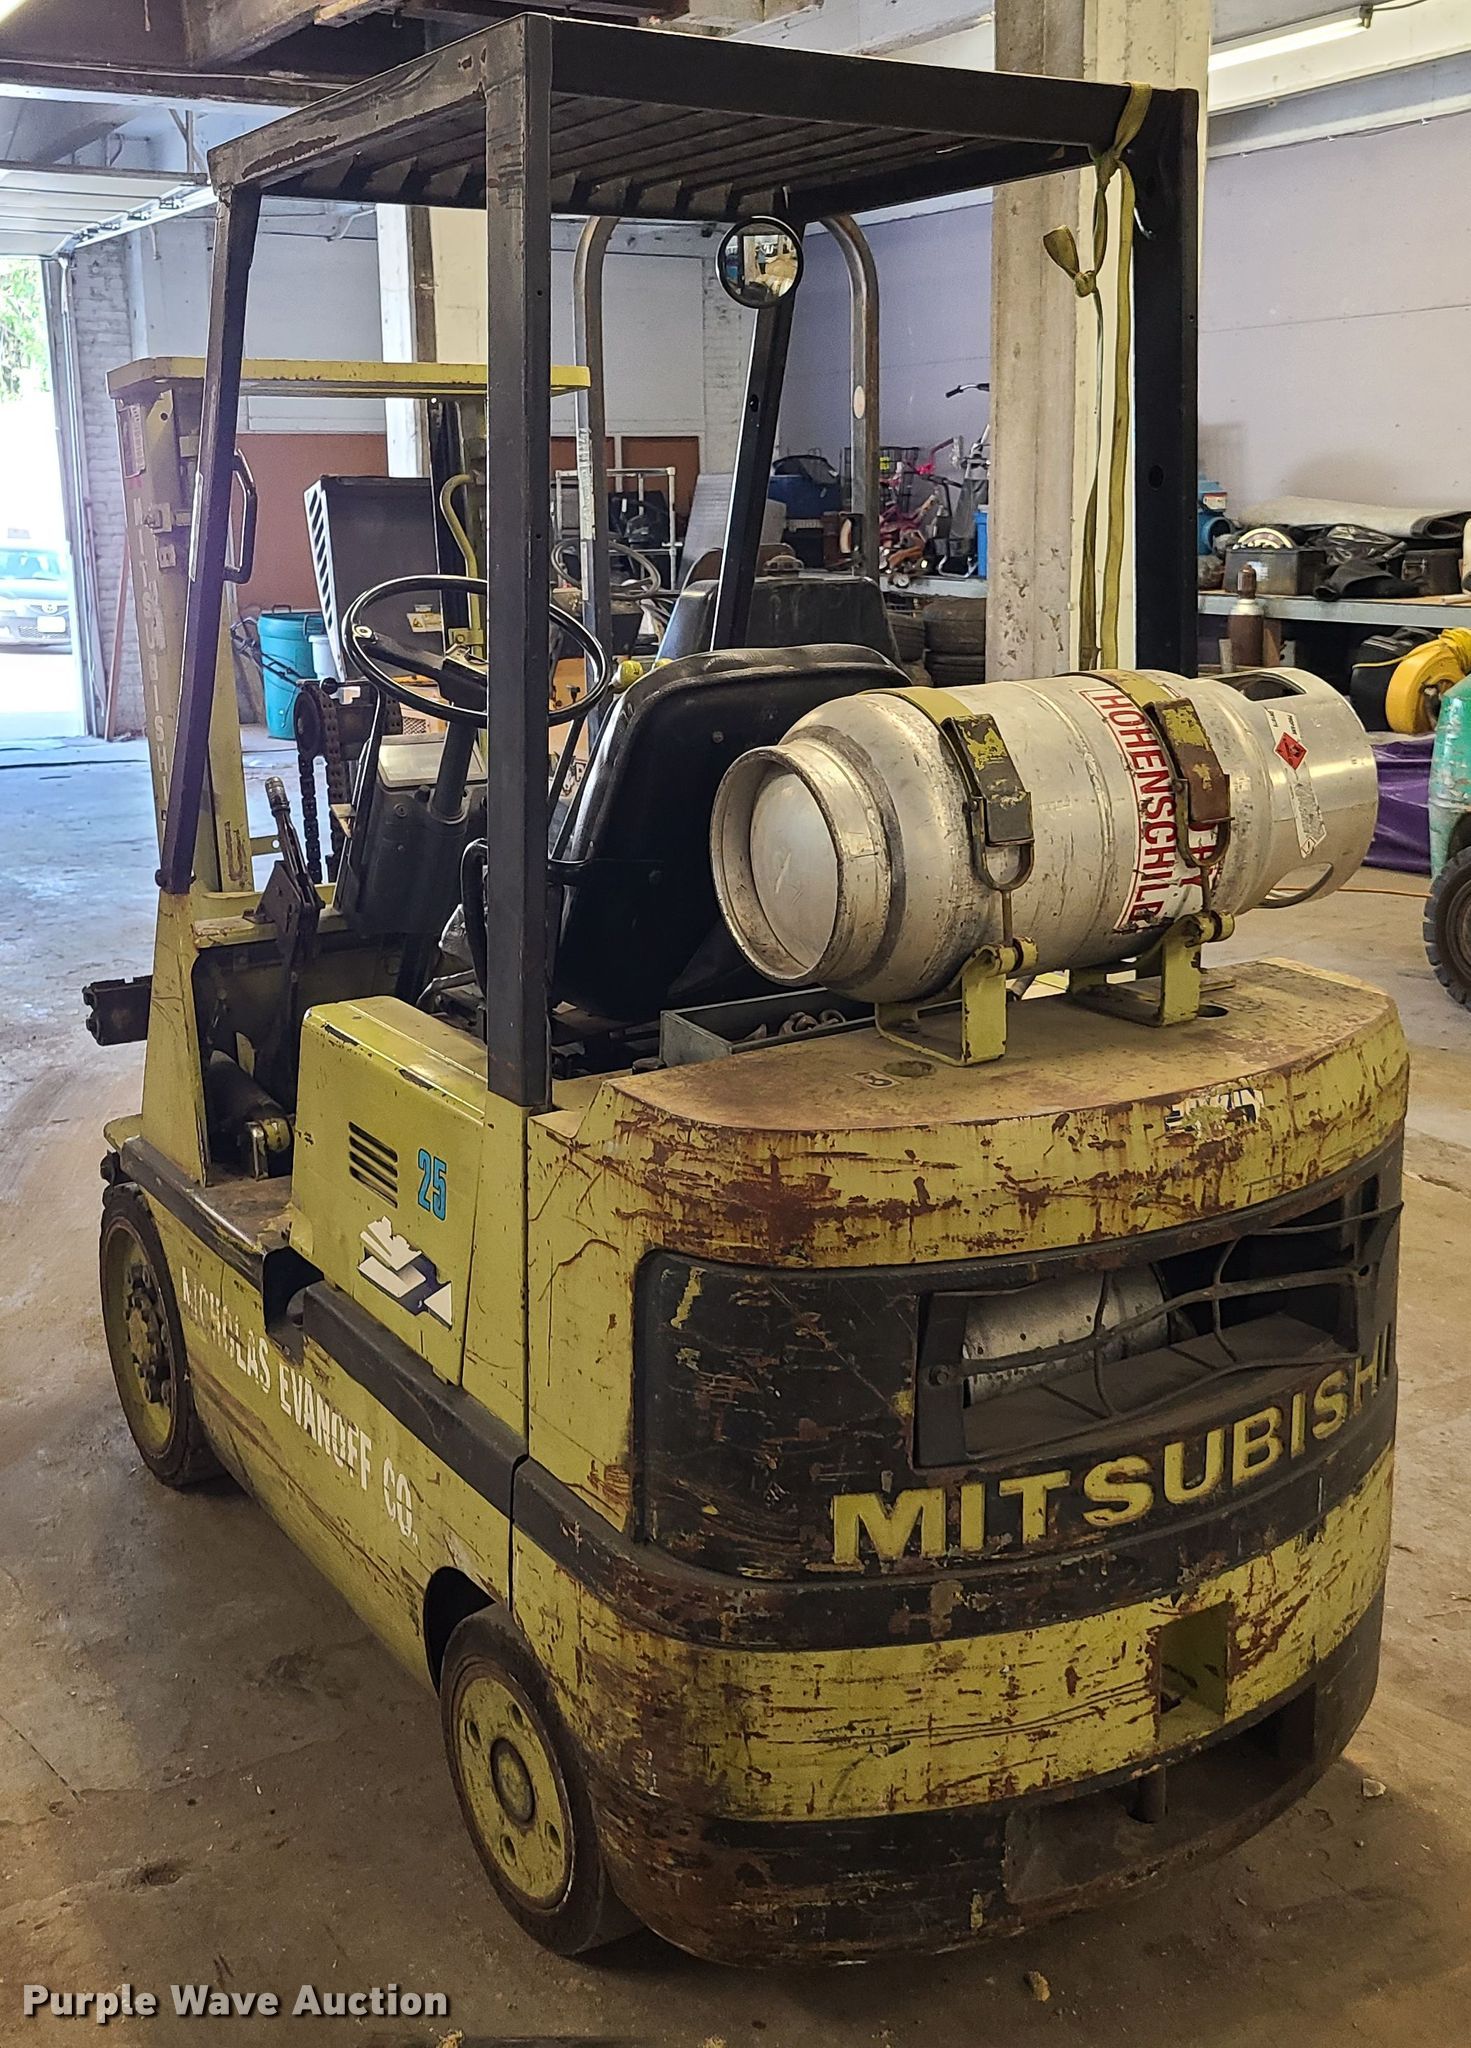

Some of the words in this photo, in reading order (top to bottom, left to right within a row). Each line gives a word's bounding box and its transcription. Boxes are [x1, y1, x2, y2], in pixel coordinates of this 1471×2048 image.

[417, 1147, 447, 1221] 25
[278, 1362, 372, 1492] EVANOFF
[833, 1321, 1391, 1564] MITSUBISHI
